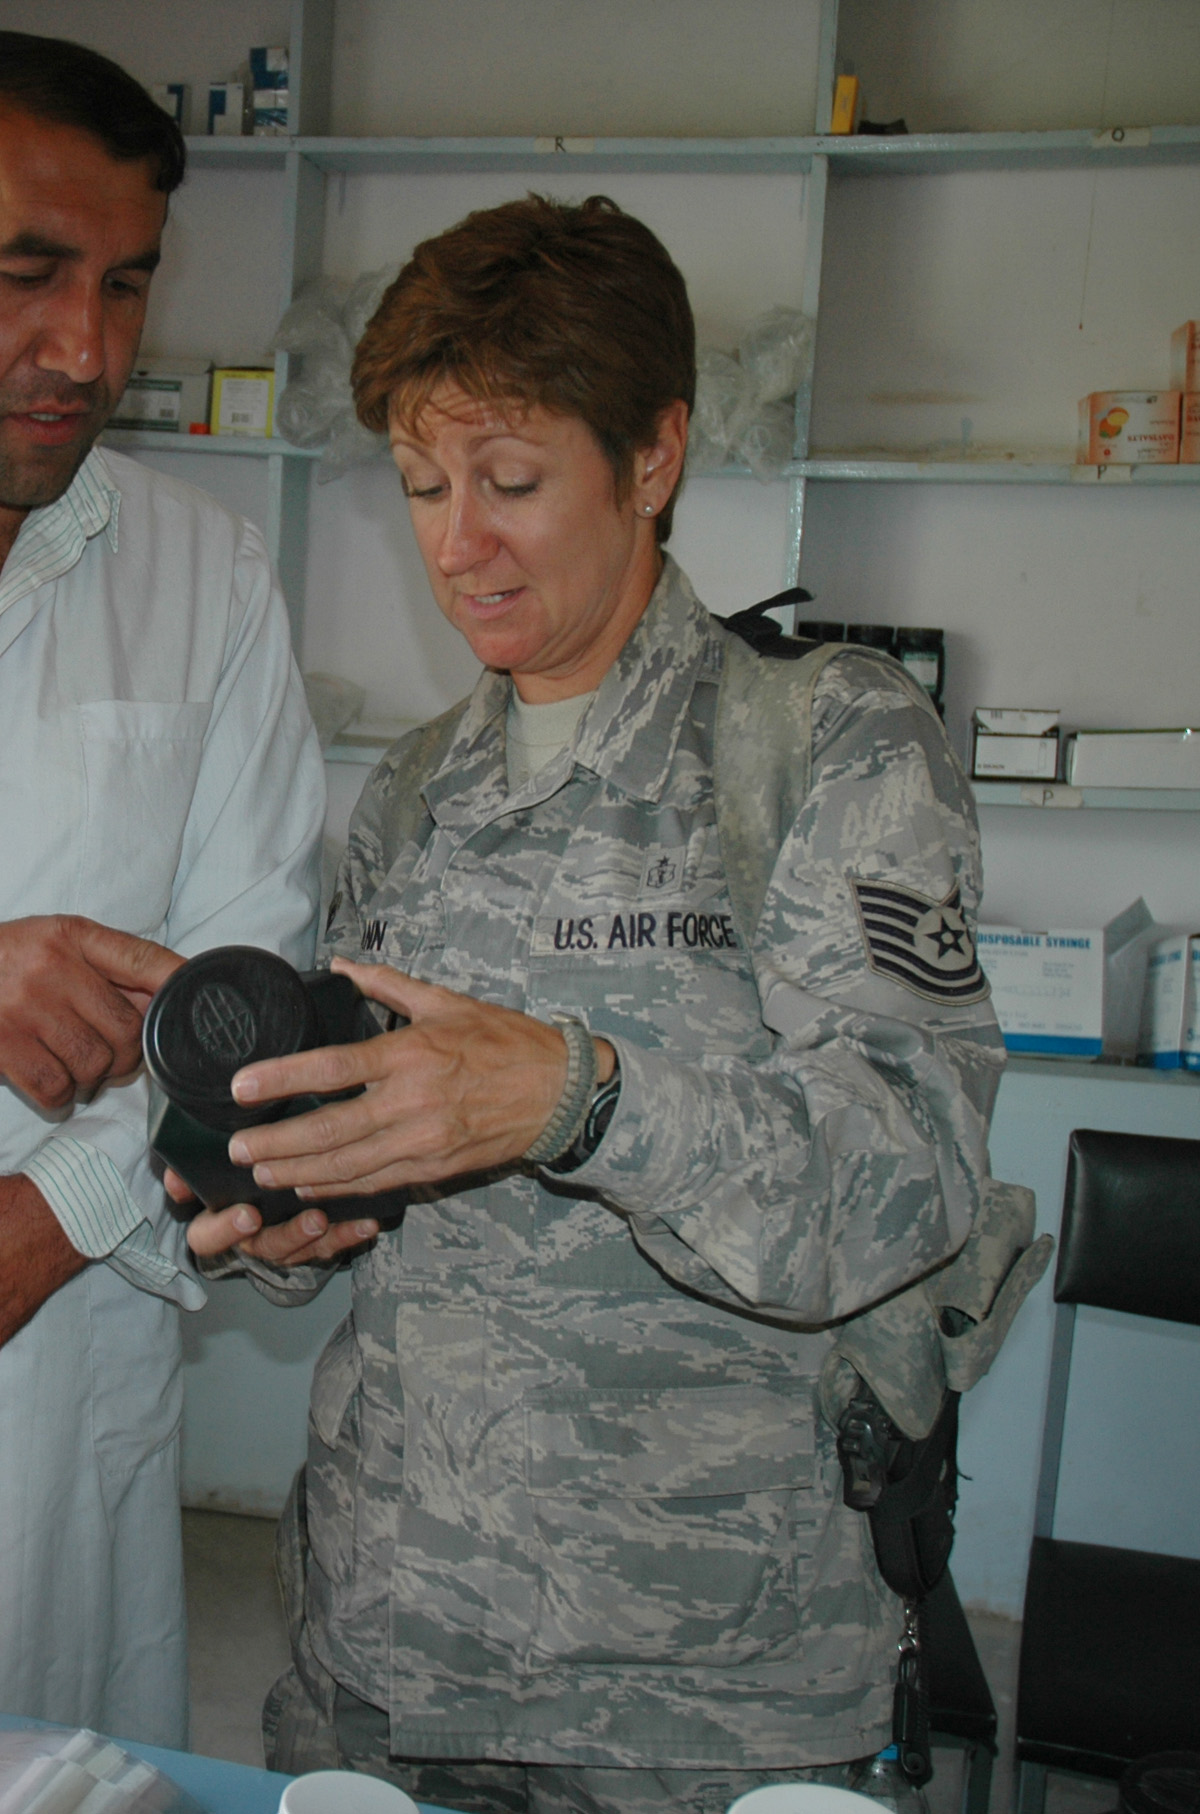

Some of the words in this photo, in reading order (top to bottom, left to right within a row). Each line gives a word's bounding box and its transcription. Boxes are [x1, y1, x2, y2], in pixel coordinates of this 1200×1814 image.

[554, 136, 567, 152] R
[1042, 788, 1055, 807] P
[554, 918, 598, 950] U.S.
[608, 912, 657, 949] AIR
[667, 912, 737, 948] FORCE
[977, 933, 1042, 947] DISPOSABLE
[1046, 935, 1091, 950] SYRINGE
